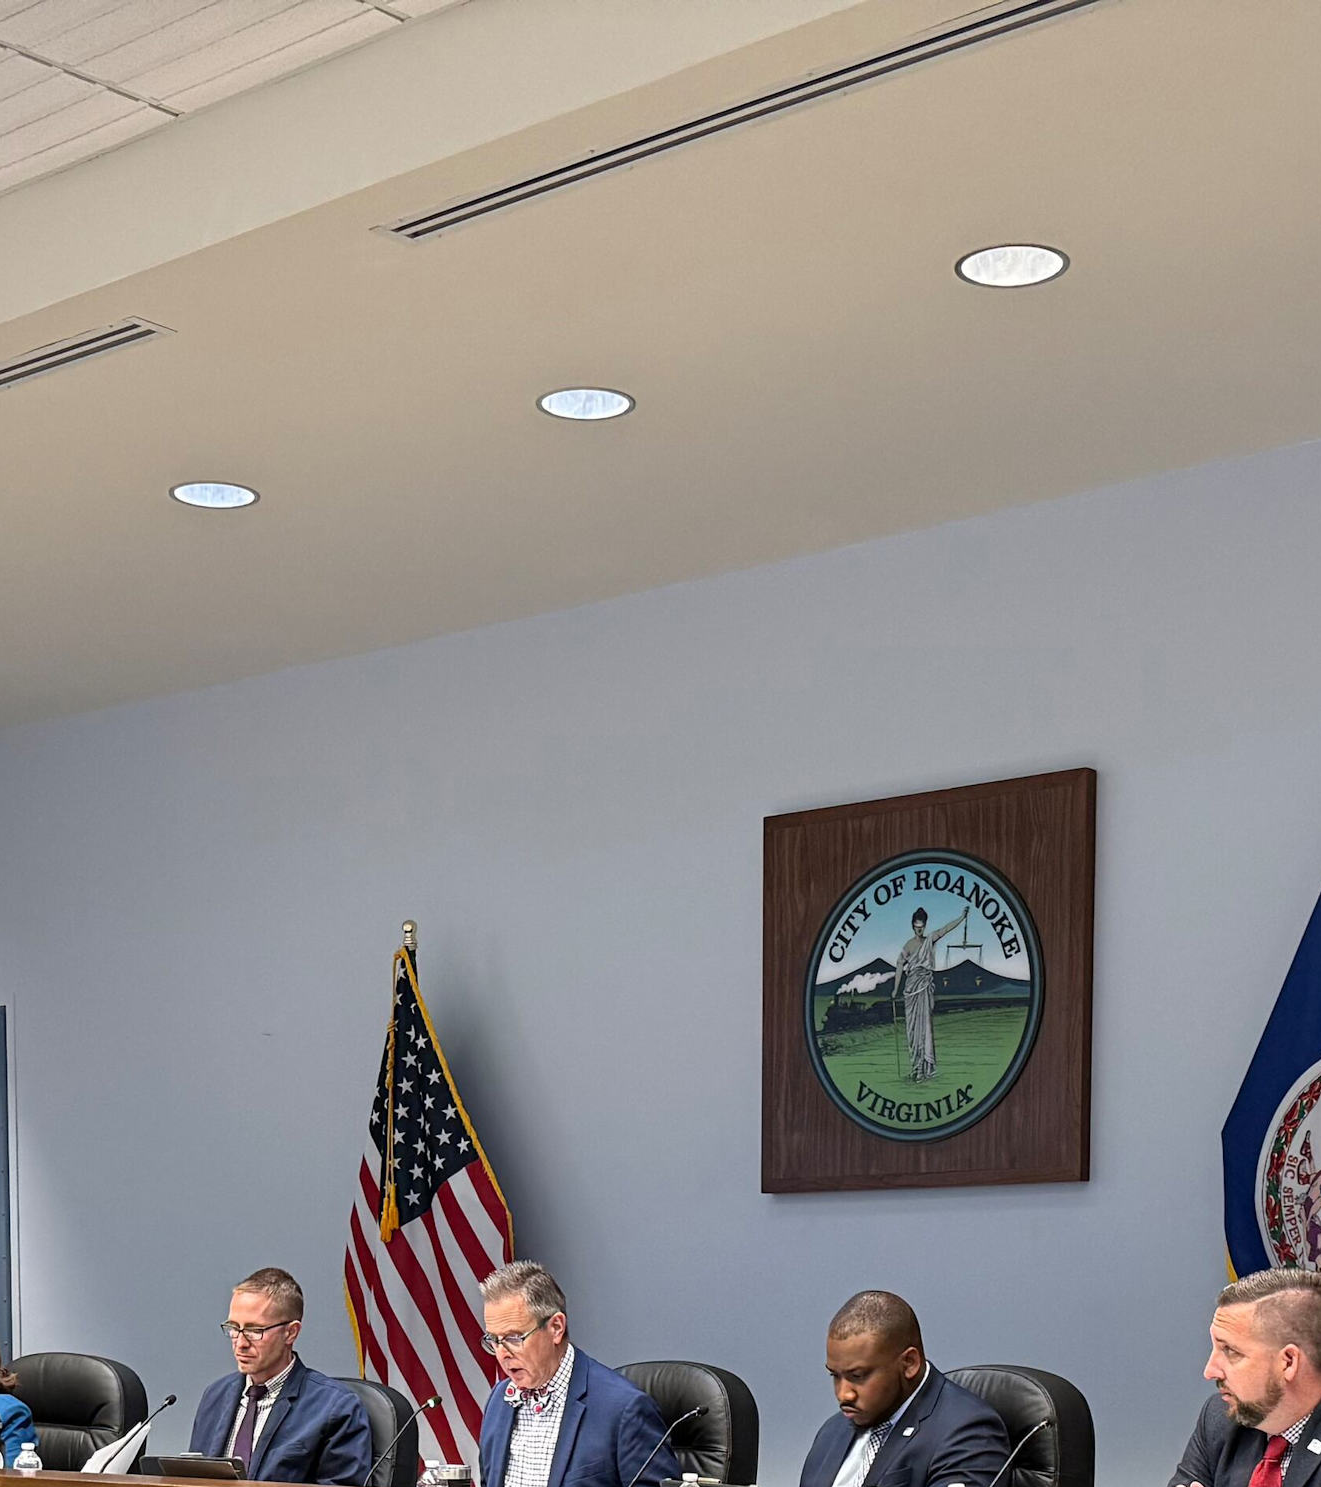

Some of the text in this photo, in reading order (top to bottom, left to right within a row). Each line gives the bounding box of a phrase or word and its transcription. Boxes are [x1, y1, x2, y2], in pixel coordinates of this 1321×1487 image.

[828, 869, 1022, 964] CITY OF ROANOKE
[856, 1080, 975, 1123] VIRGINIA
[1284, 1155, 1298, 1180] SIC
[1282, 1186, 1302, 1245] SEMPER
